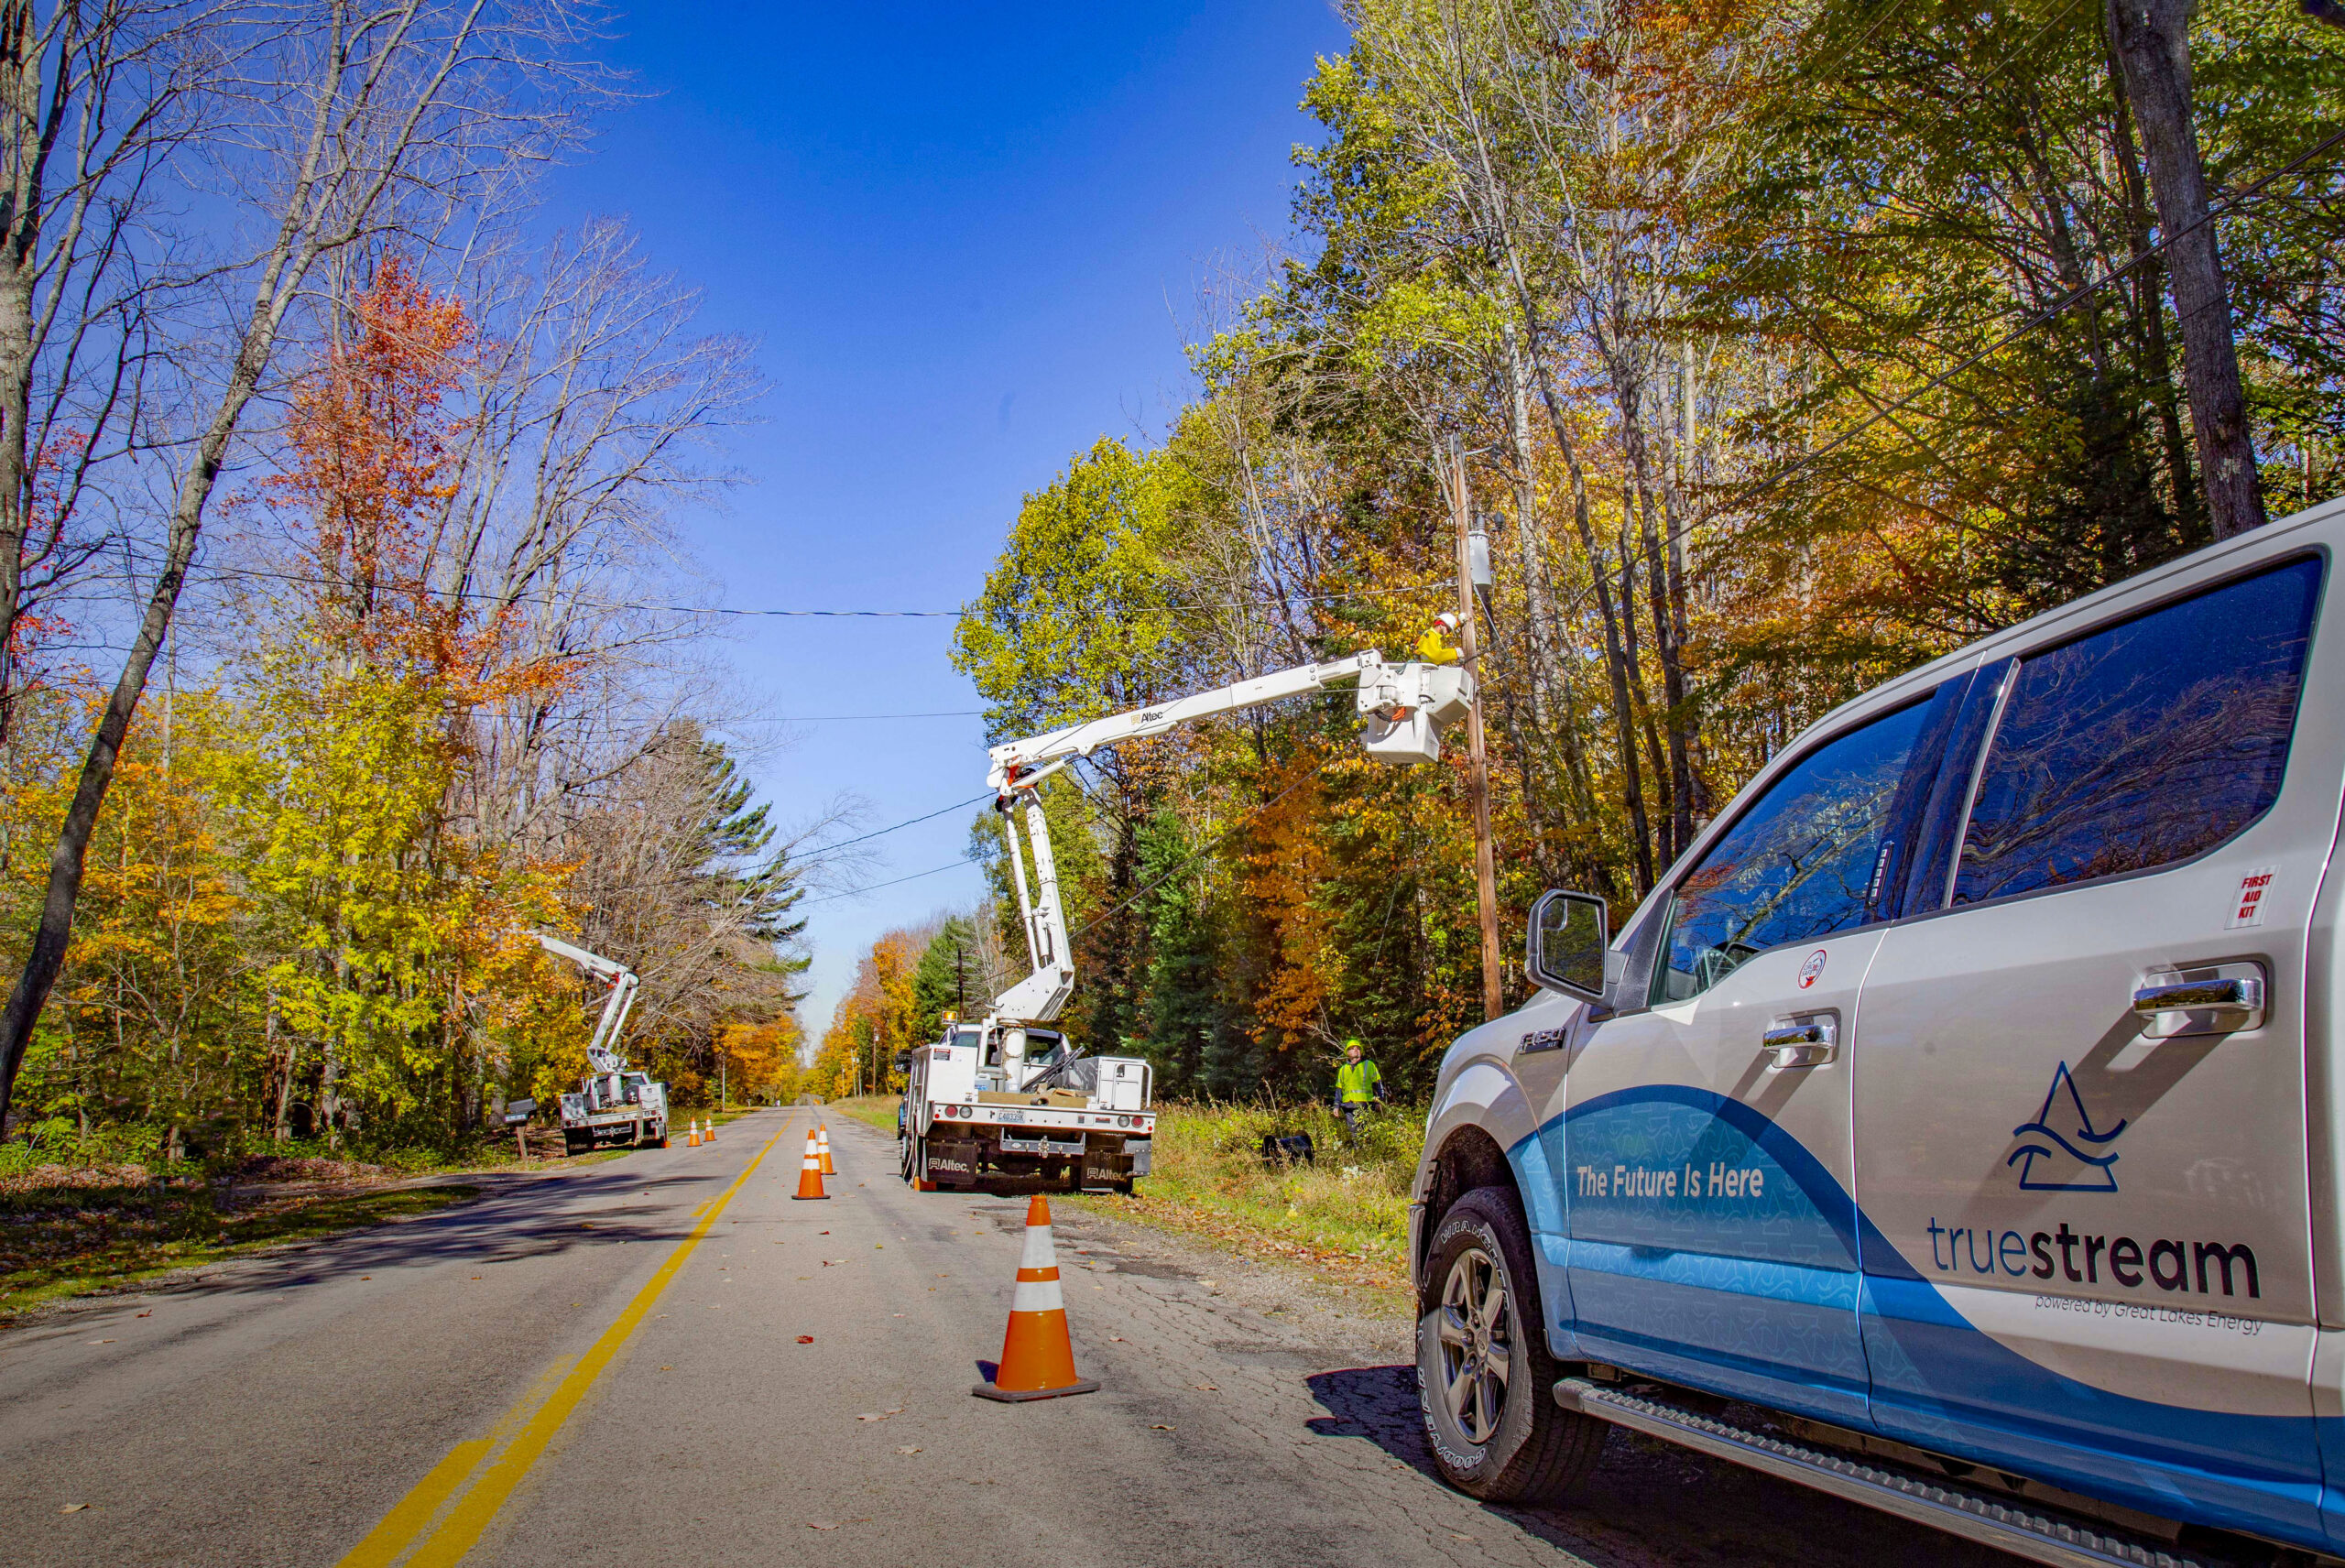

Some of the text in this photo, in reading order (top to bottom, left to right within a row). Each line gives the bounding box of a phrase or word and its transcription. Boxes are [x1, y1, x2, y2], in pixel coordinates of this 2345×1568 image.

[1141, 712, 1163, 723] Altec
[2241, 874, 2273, 889] FIRST
[2242, 890, 2262, 903] AID
[2238, 906, 2256, 919] KIT
[1577, 1161, 1763, 1197] The Future Is Here
[1926, 1216, 2261, 1299] truestream
[2034, 1294, 2263, 1335] powered by Great Lakes Energy
[1417, 1366, 1486, 1468] GOODYEAR
